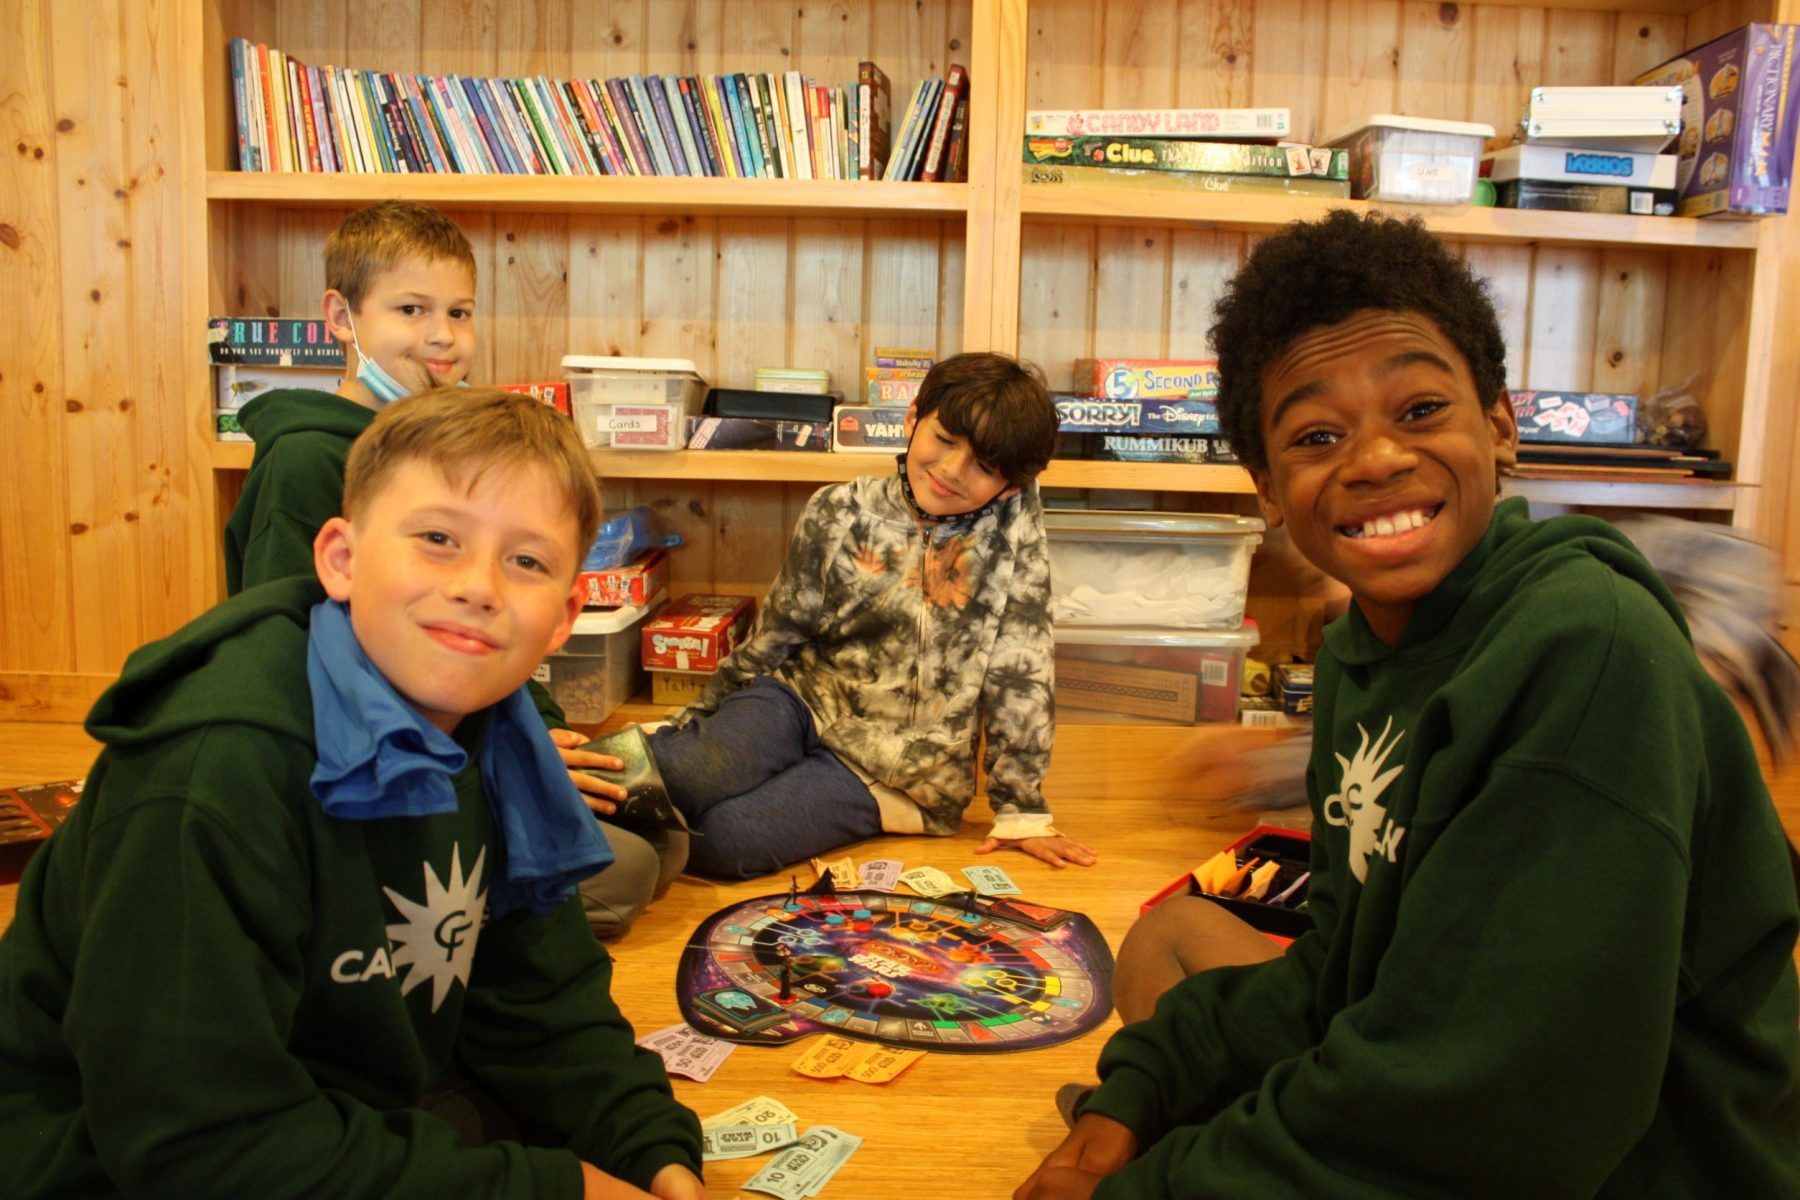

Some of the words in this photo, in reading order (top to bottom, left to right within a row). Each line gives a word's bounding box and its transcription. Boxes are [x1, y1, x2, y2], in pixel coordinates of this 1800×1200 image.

[1086, 112, 1161, 133] CANDY
[1164, 112, 1221, 132] LAND
[1106, 142, 1155, 164] Clue
[1204, 178, 1230, 192] Clue
[1113, 372, 1132, 399] 5
[1144, 371, 1202, 390] SECOND
[1056, 401, 1142, 426] SORRY!
[609, 419, 641, 430] Cards
[1104, 436, 1208, 453] RUMMIKUB
[755, 1110, 776, 1122] 20
[762, 1131, 782, 1144] 10
[767, 1172, 785, 1182] 10
